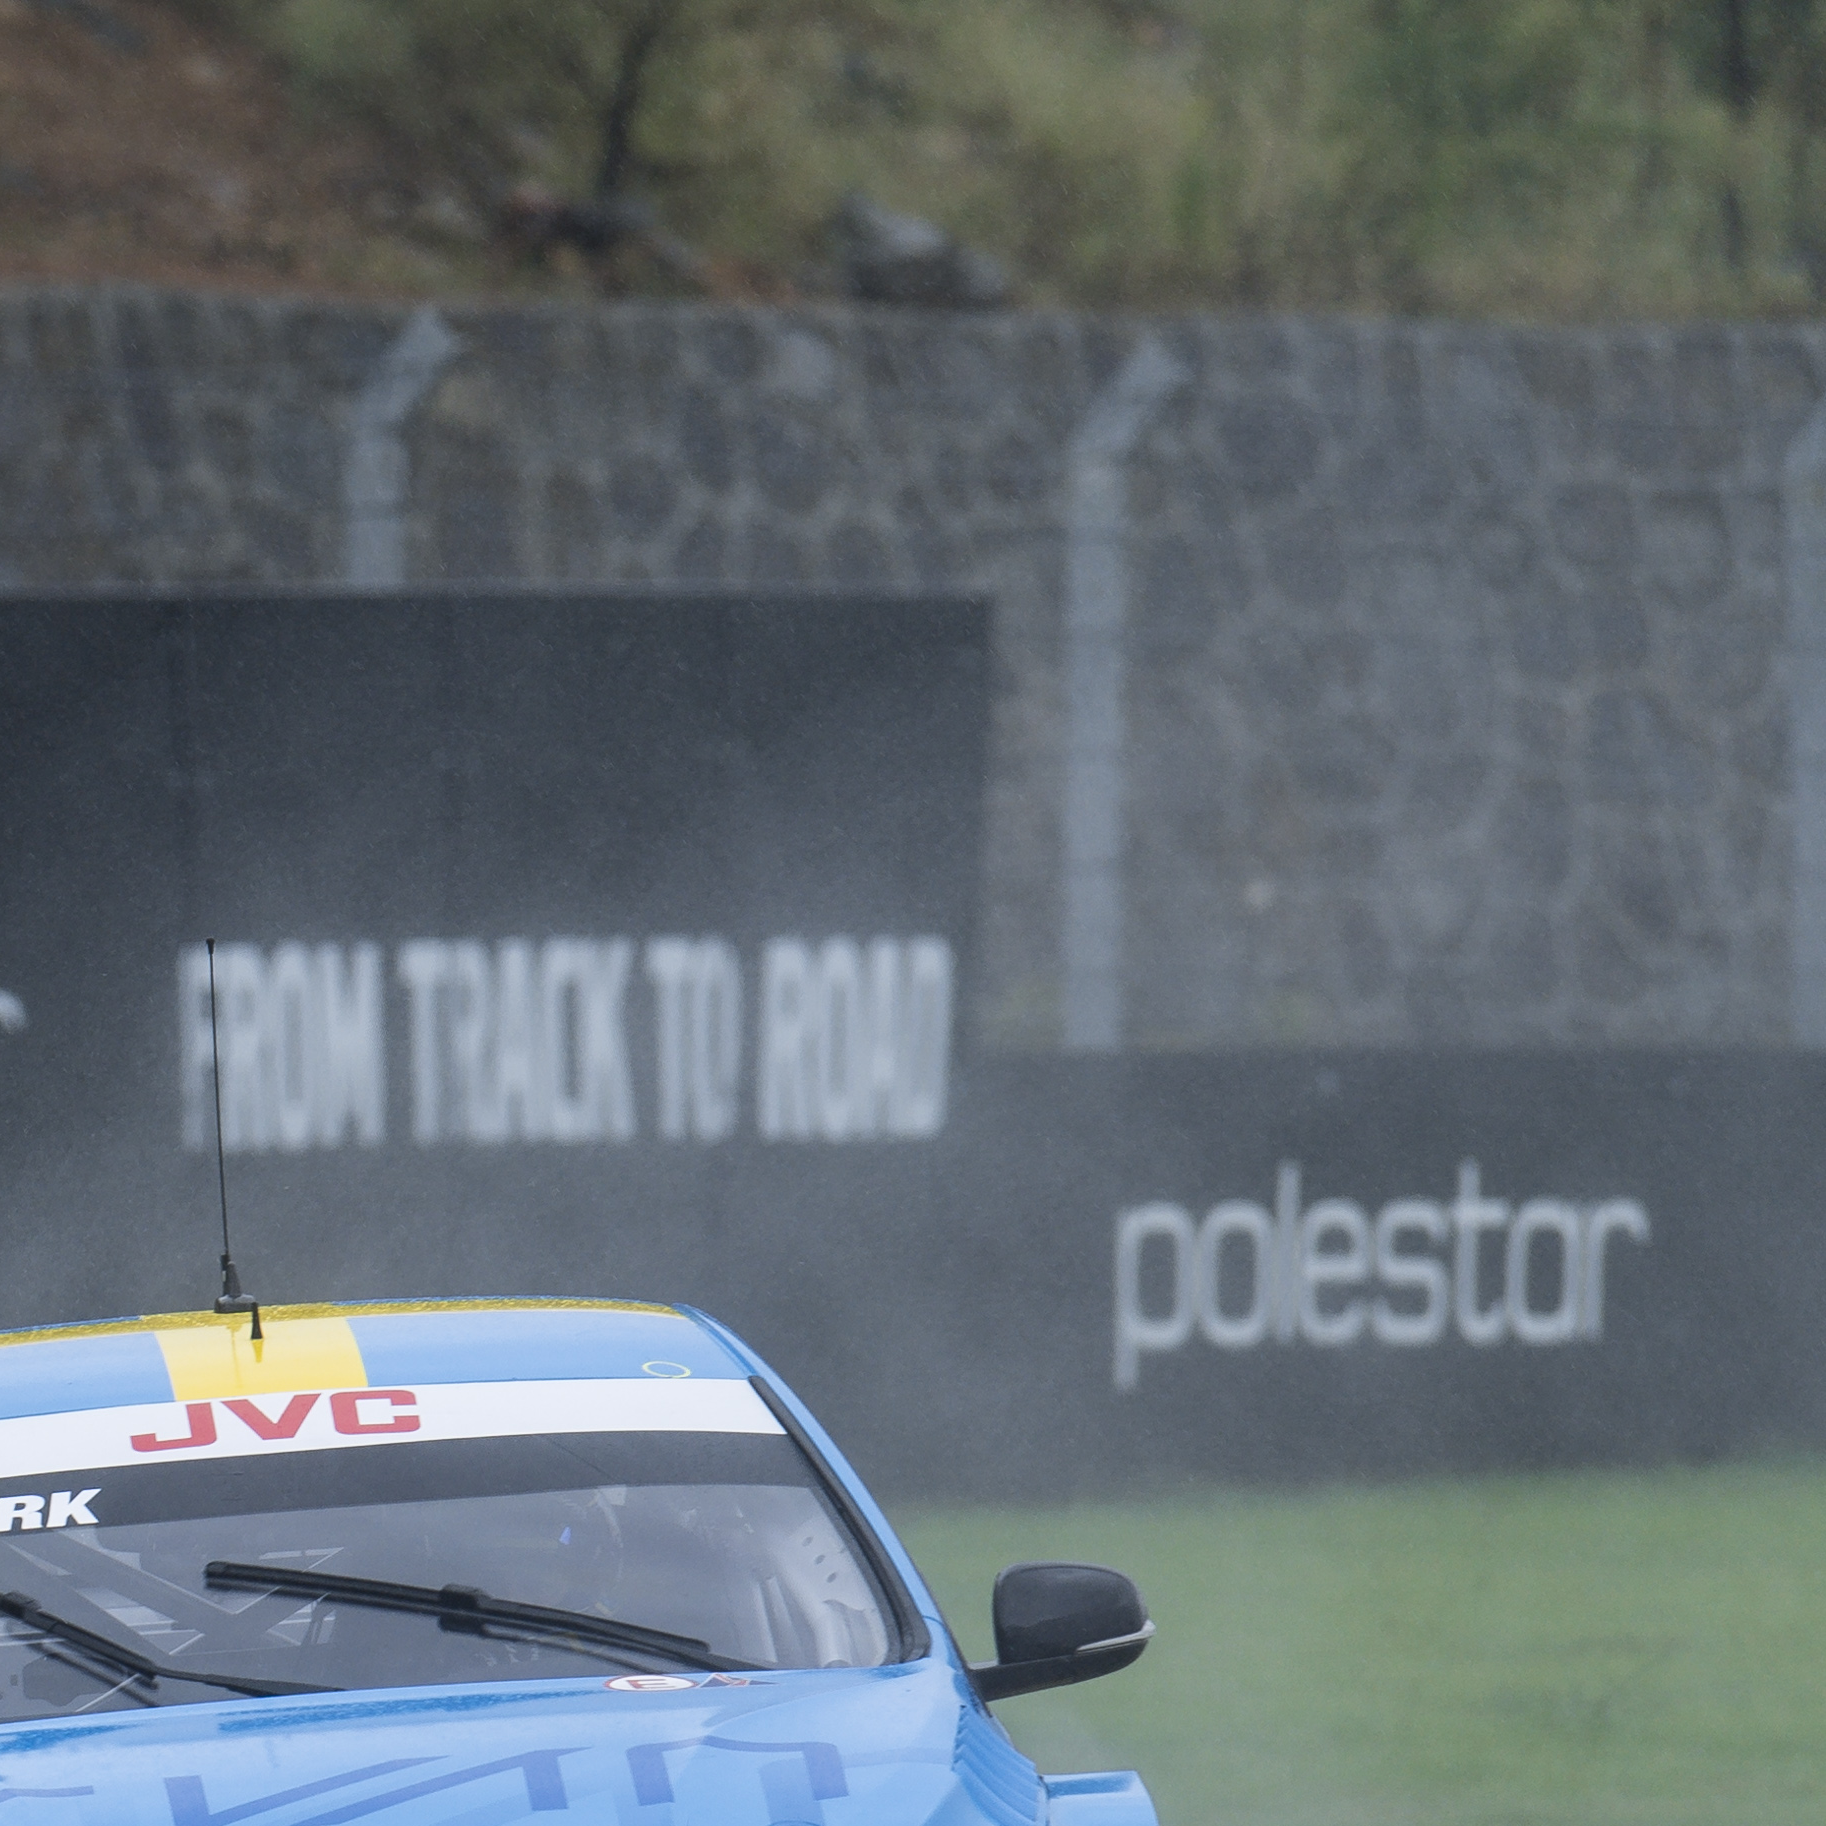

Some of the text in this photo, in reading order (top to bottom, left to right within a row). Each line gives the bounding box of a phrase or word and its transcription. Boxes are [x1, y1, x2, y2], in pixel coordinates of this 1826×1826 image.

[181, 936, 953, 1151] FROM TRACK TO ROAD
[1112, 1159, 1651, 1393] polestar
[130, 1388, 420, 1453] JVC
